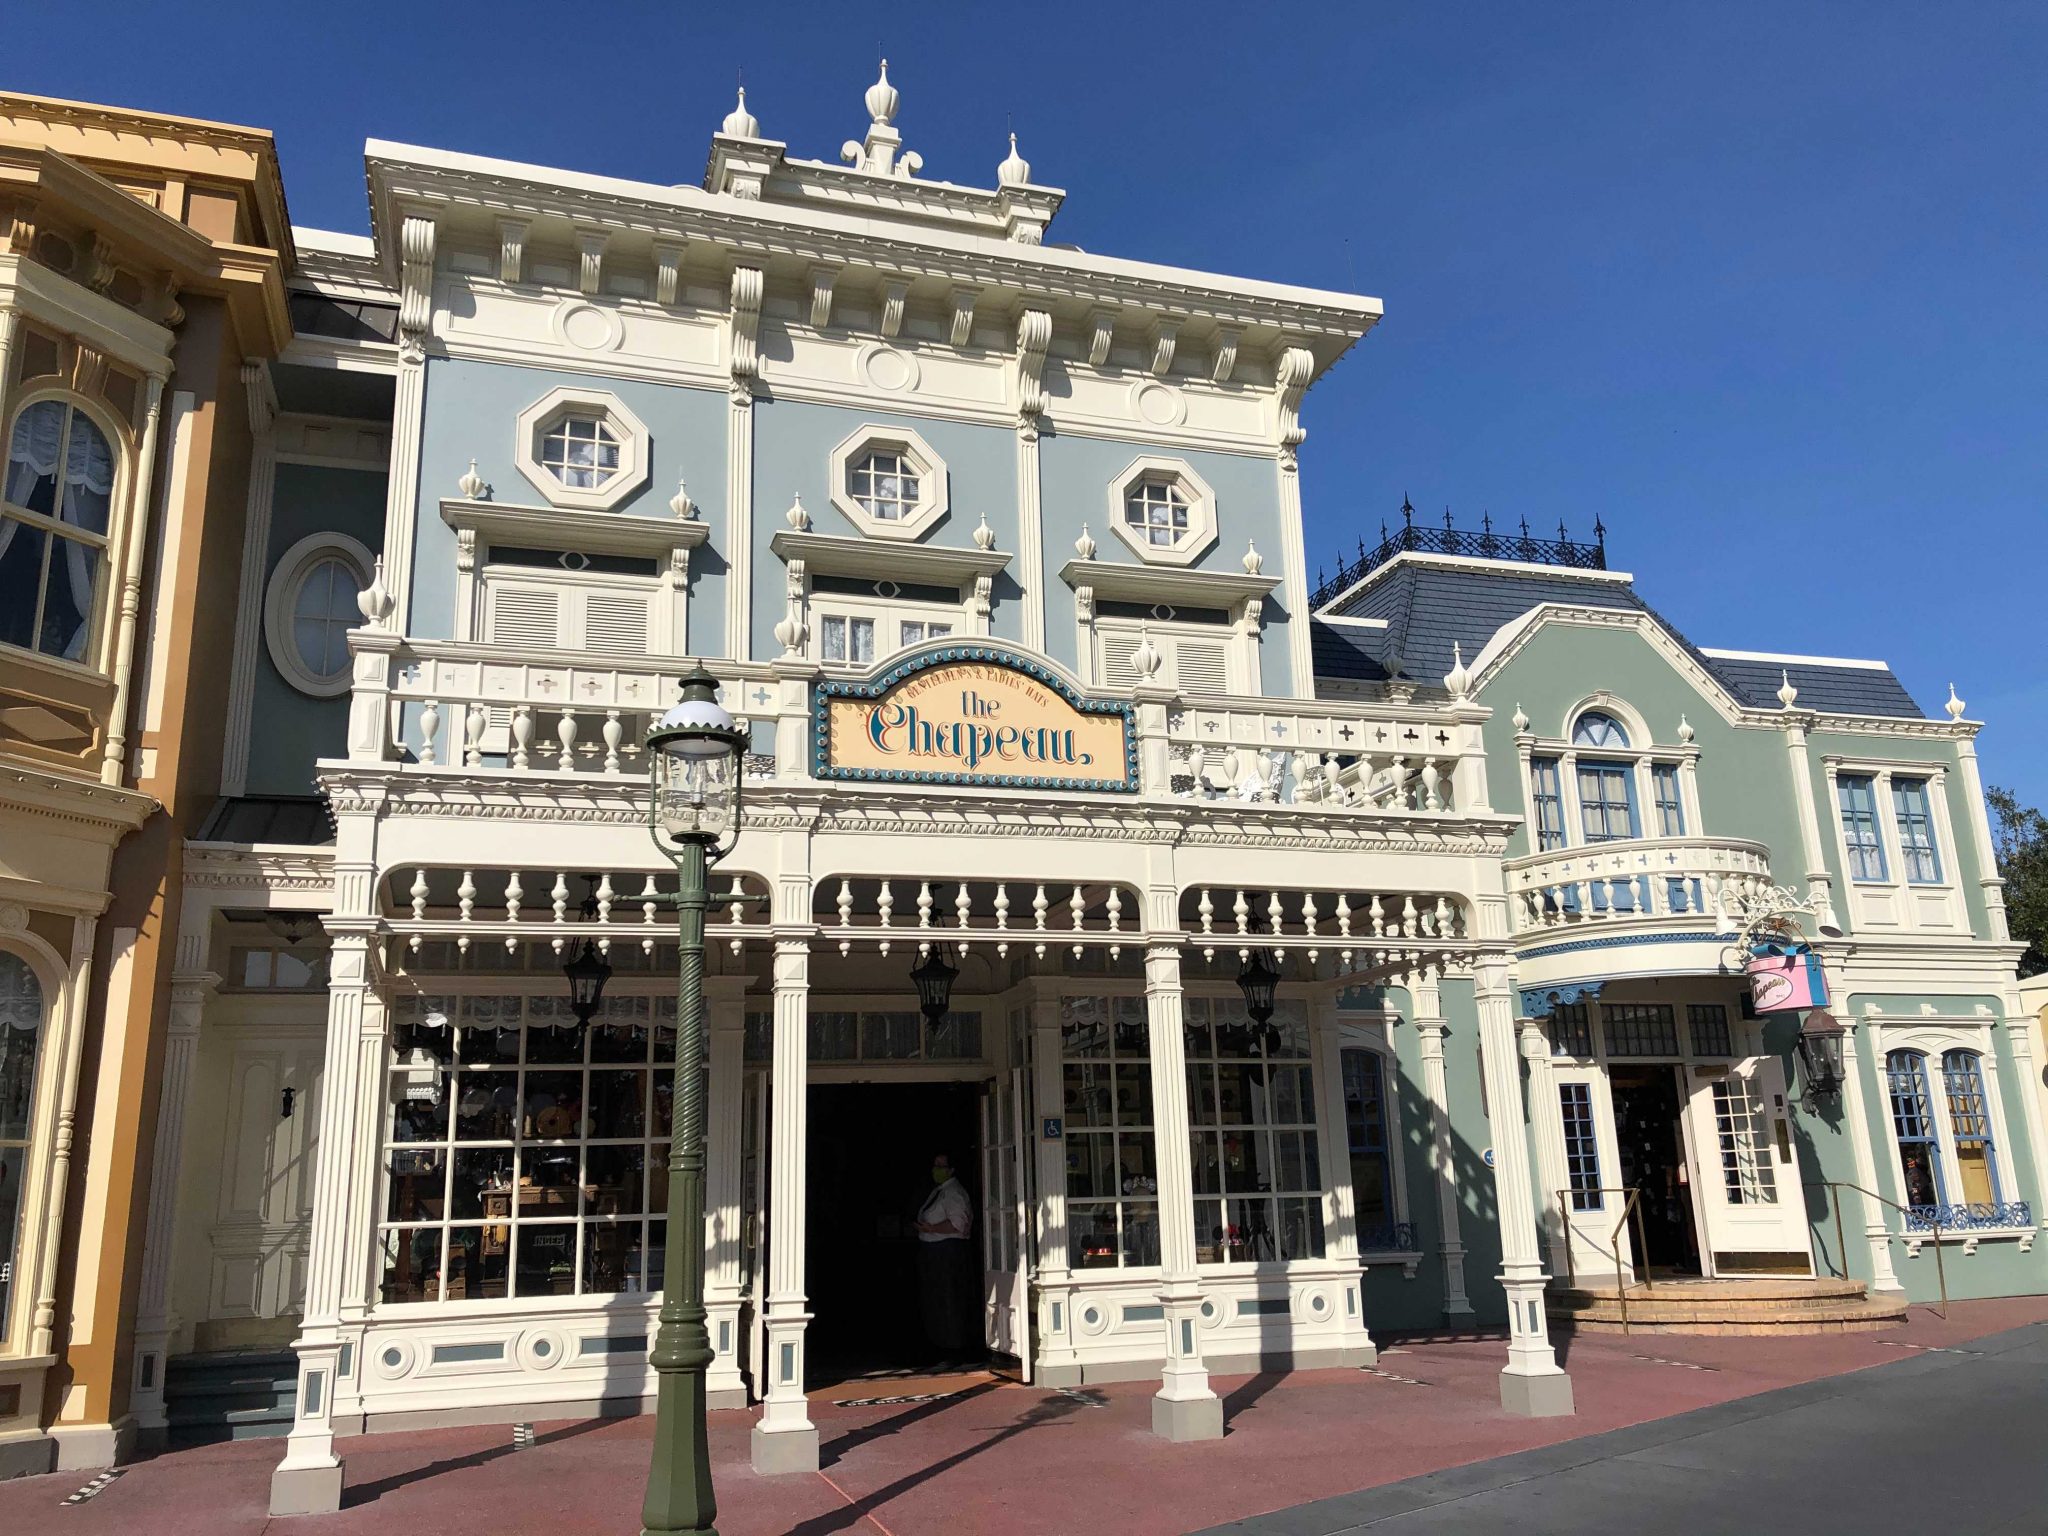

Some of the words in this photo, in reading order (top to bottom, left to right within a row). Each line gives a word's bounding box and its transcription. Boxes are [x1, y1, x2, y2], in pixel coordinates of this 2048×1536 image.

[961, 689, 1002, 719] the
[975, 669, 984, 680] &
[1025, 686, 1049, 708] HATS
[866, 703, 1094, 771] Chapeau
